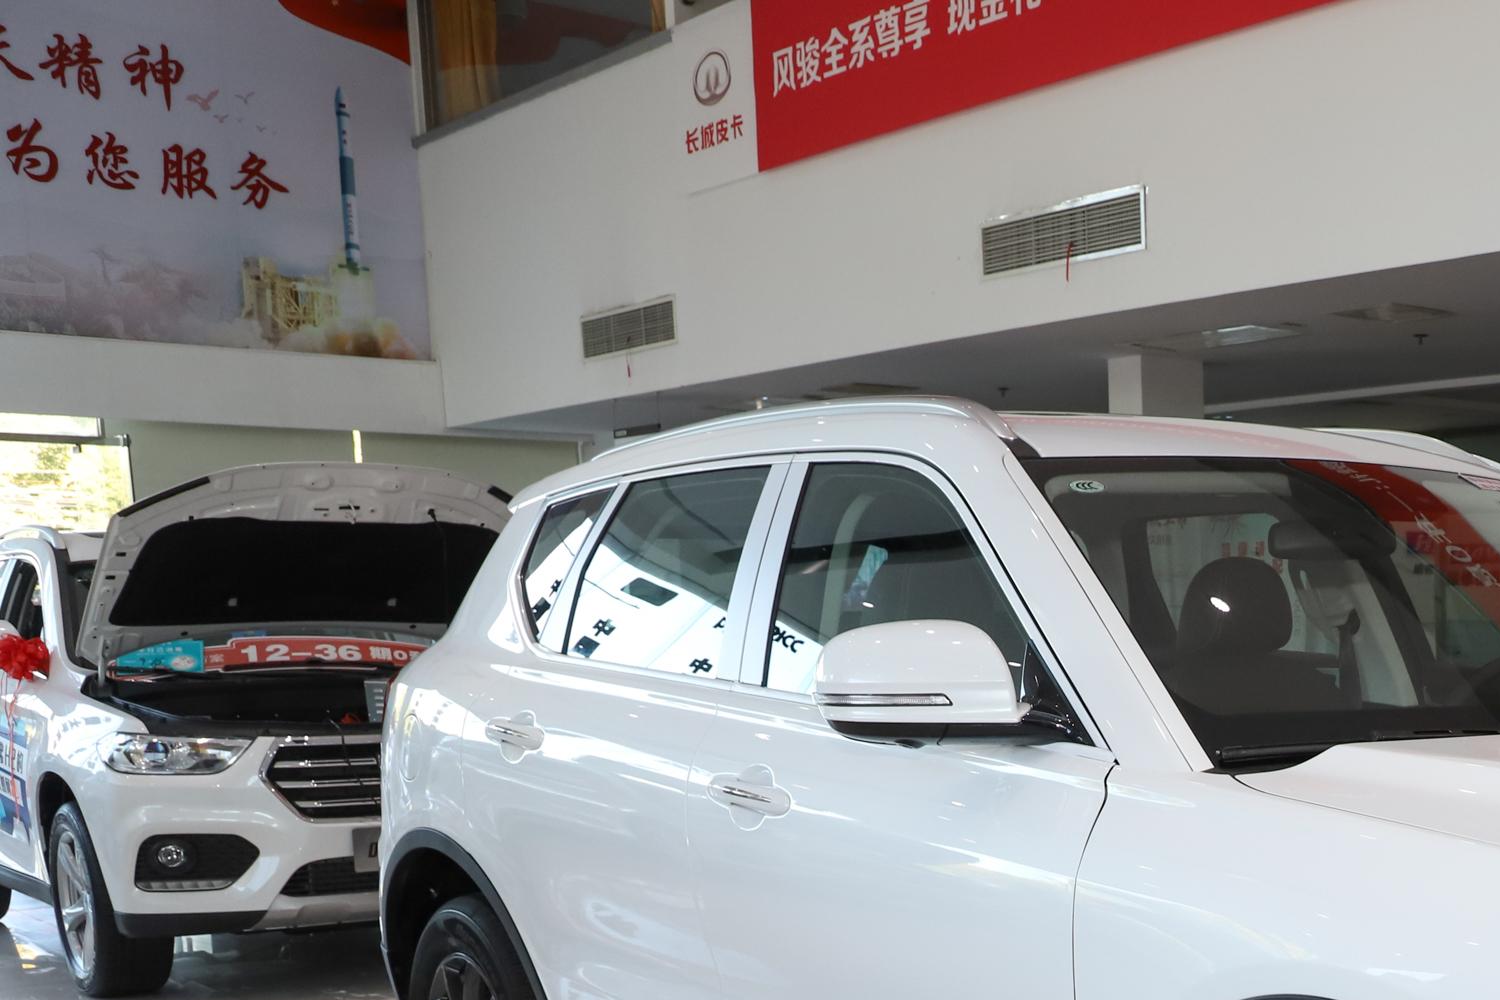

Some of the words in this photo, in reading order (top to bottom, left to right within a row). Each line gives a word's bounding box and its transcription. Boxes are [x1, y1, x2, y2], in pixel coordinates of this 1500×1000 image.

[772, 0, 931, 98] 风骏全系尊享
[6, 118, 290, 210] 为您服务
[685, 114, 744, 154] 长城皮卡
